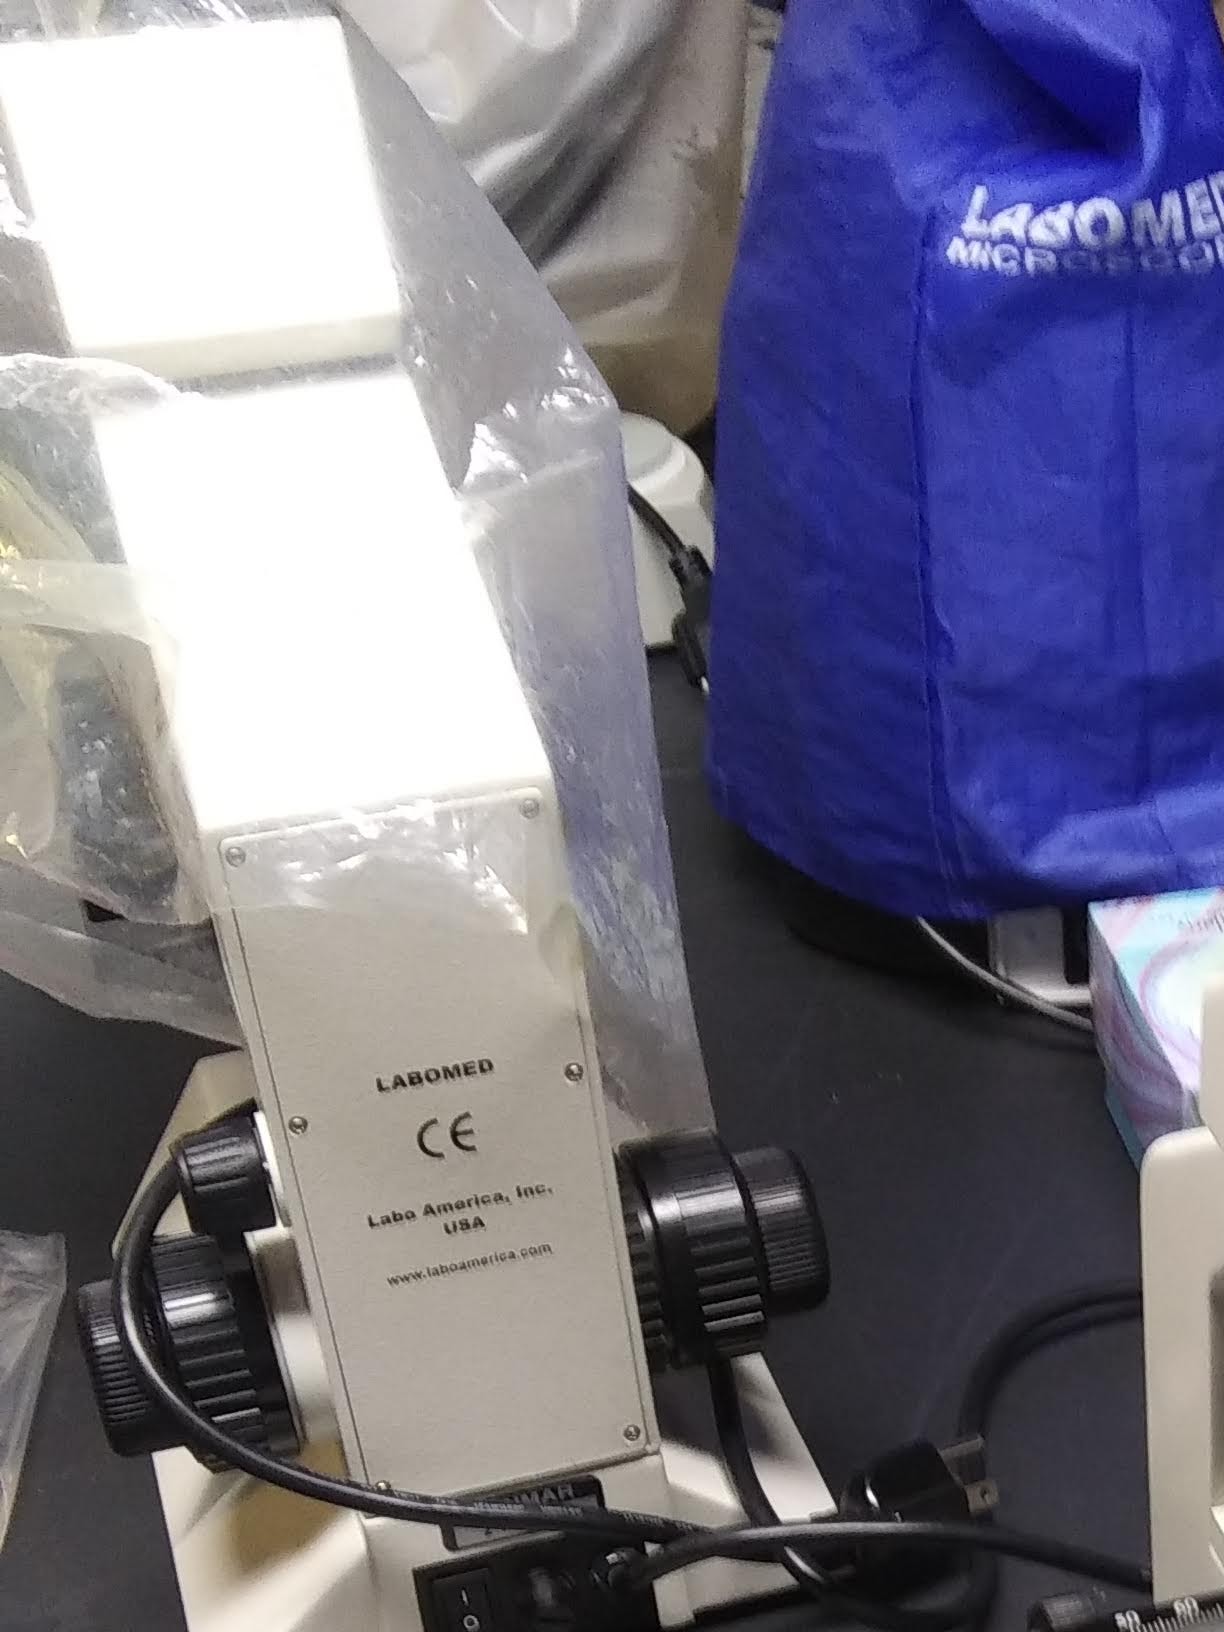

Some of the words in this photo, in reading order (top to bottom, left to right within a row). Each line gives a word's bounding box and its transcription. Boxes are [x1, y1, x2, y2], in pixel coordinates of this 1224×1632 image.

[375, 1058, 495, 1093] LABOMED
[367, 1210, 416, 1229] Labo
[443, 1216, 485, 1235] USA
[387, 1243, 552, 1287] www.laboamerica.com
